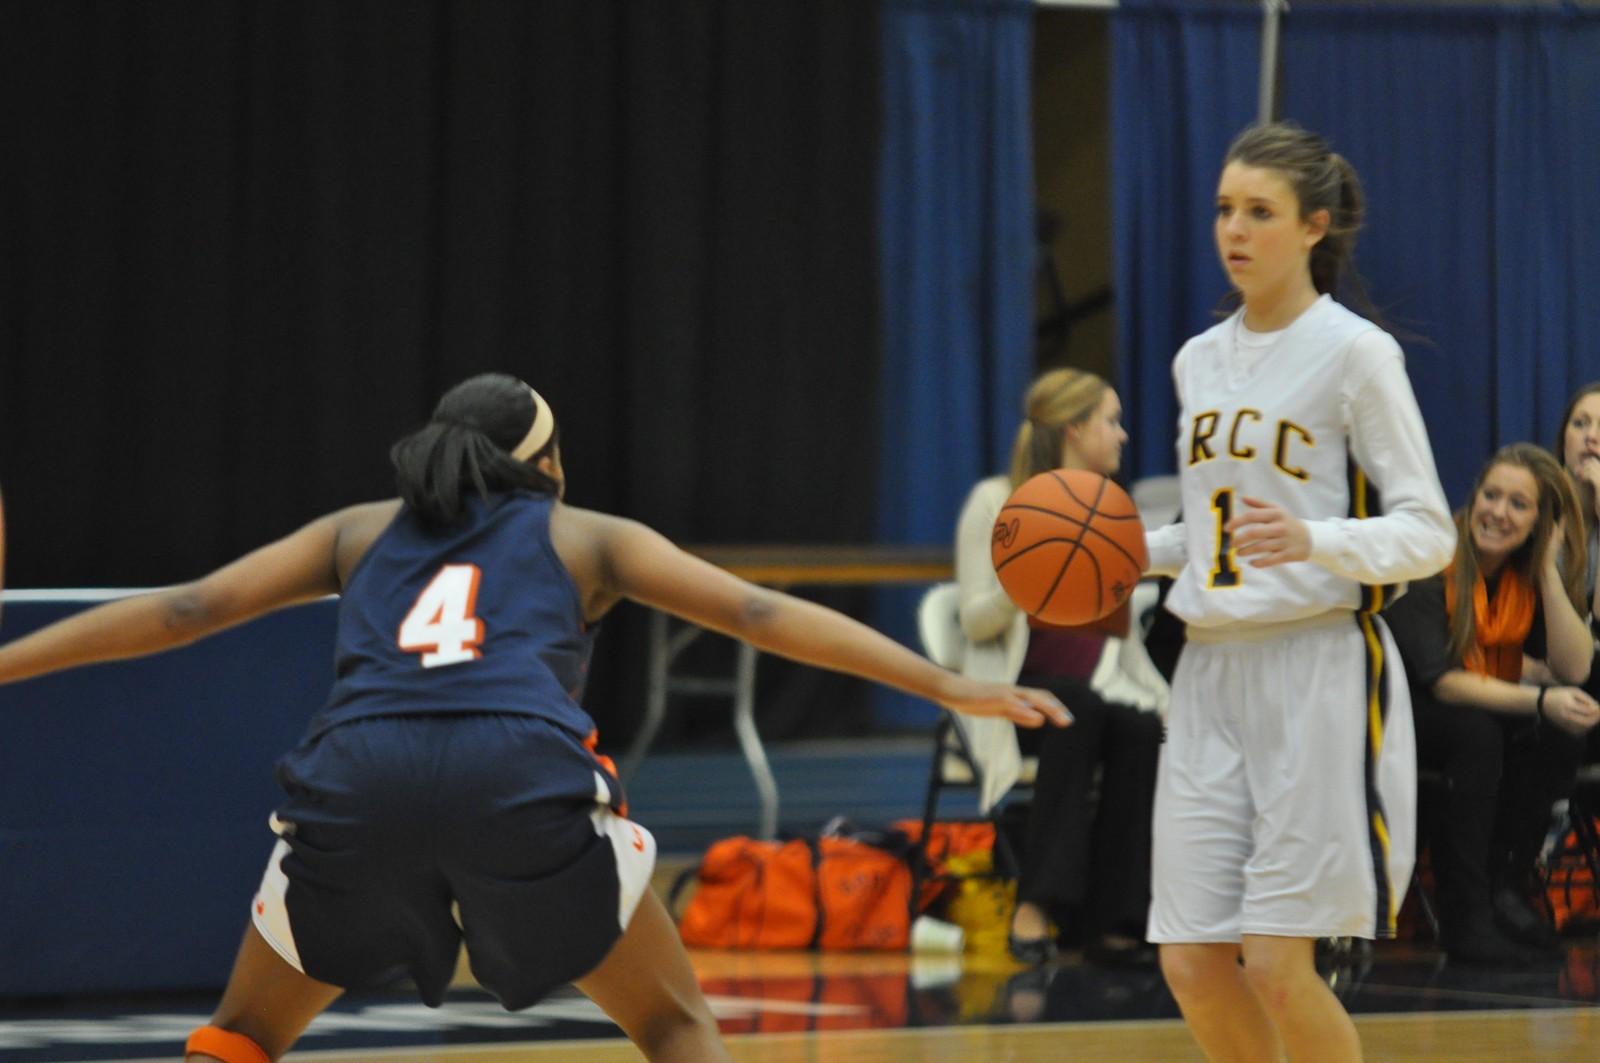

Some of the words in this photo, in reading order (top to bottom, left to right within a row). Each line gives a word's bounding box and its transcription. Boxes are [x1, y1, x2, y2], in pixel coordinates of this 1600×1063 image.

[1188, 407, 1315, 482] RCC
[1207, 487, 1243, 589] 1
[398, 563, 485, 668] 4
